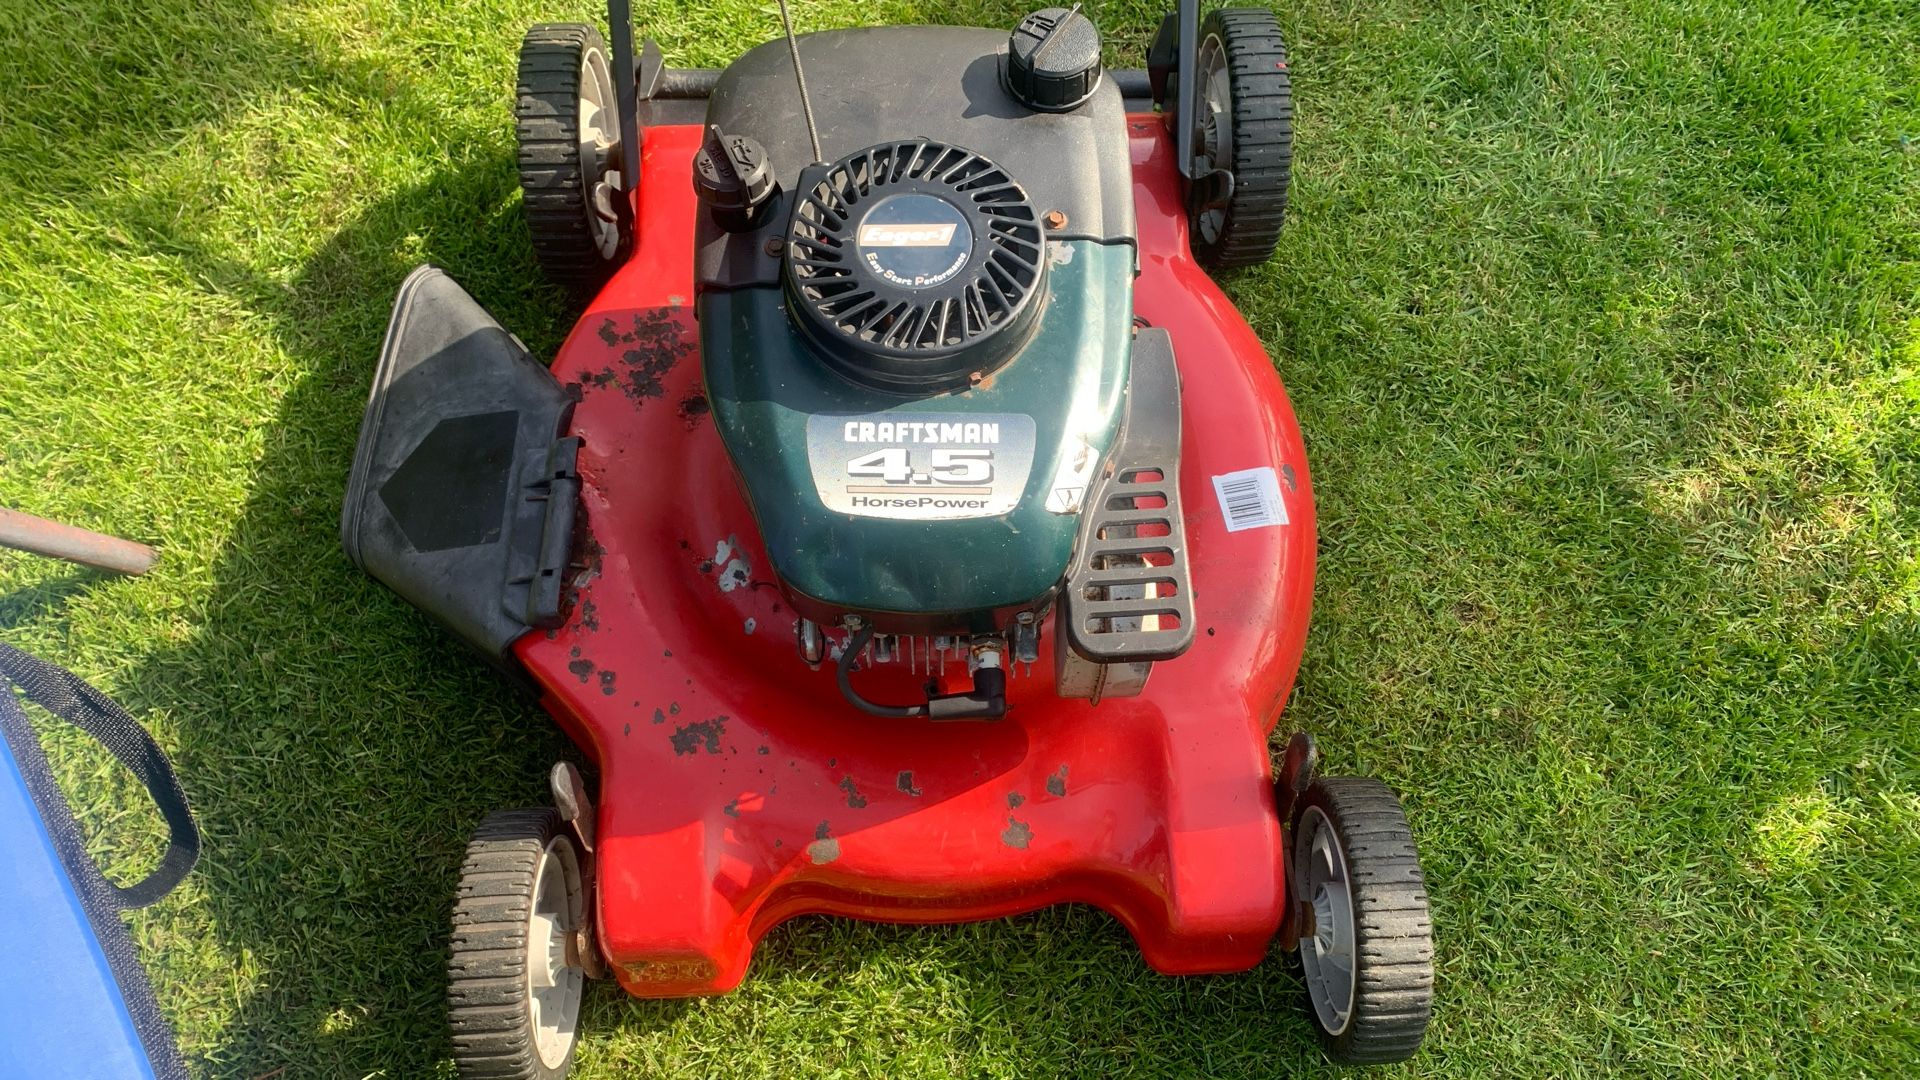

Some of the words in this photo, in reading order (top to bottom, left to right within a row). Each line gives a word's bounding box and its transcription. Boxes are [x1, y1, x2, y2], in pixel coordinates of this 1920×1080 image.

[865, 252, 886, 274] Easy
[883, 269, 913, 286] Start
[914, 252, 967, 286] Performance
[844, 421, 999, 444] CRAFTSMAN
[847, 448, 994, 485] 4.5
[851, 496, 989, 509] HorsePower
